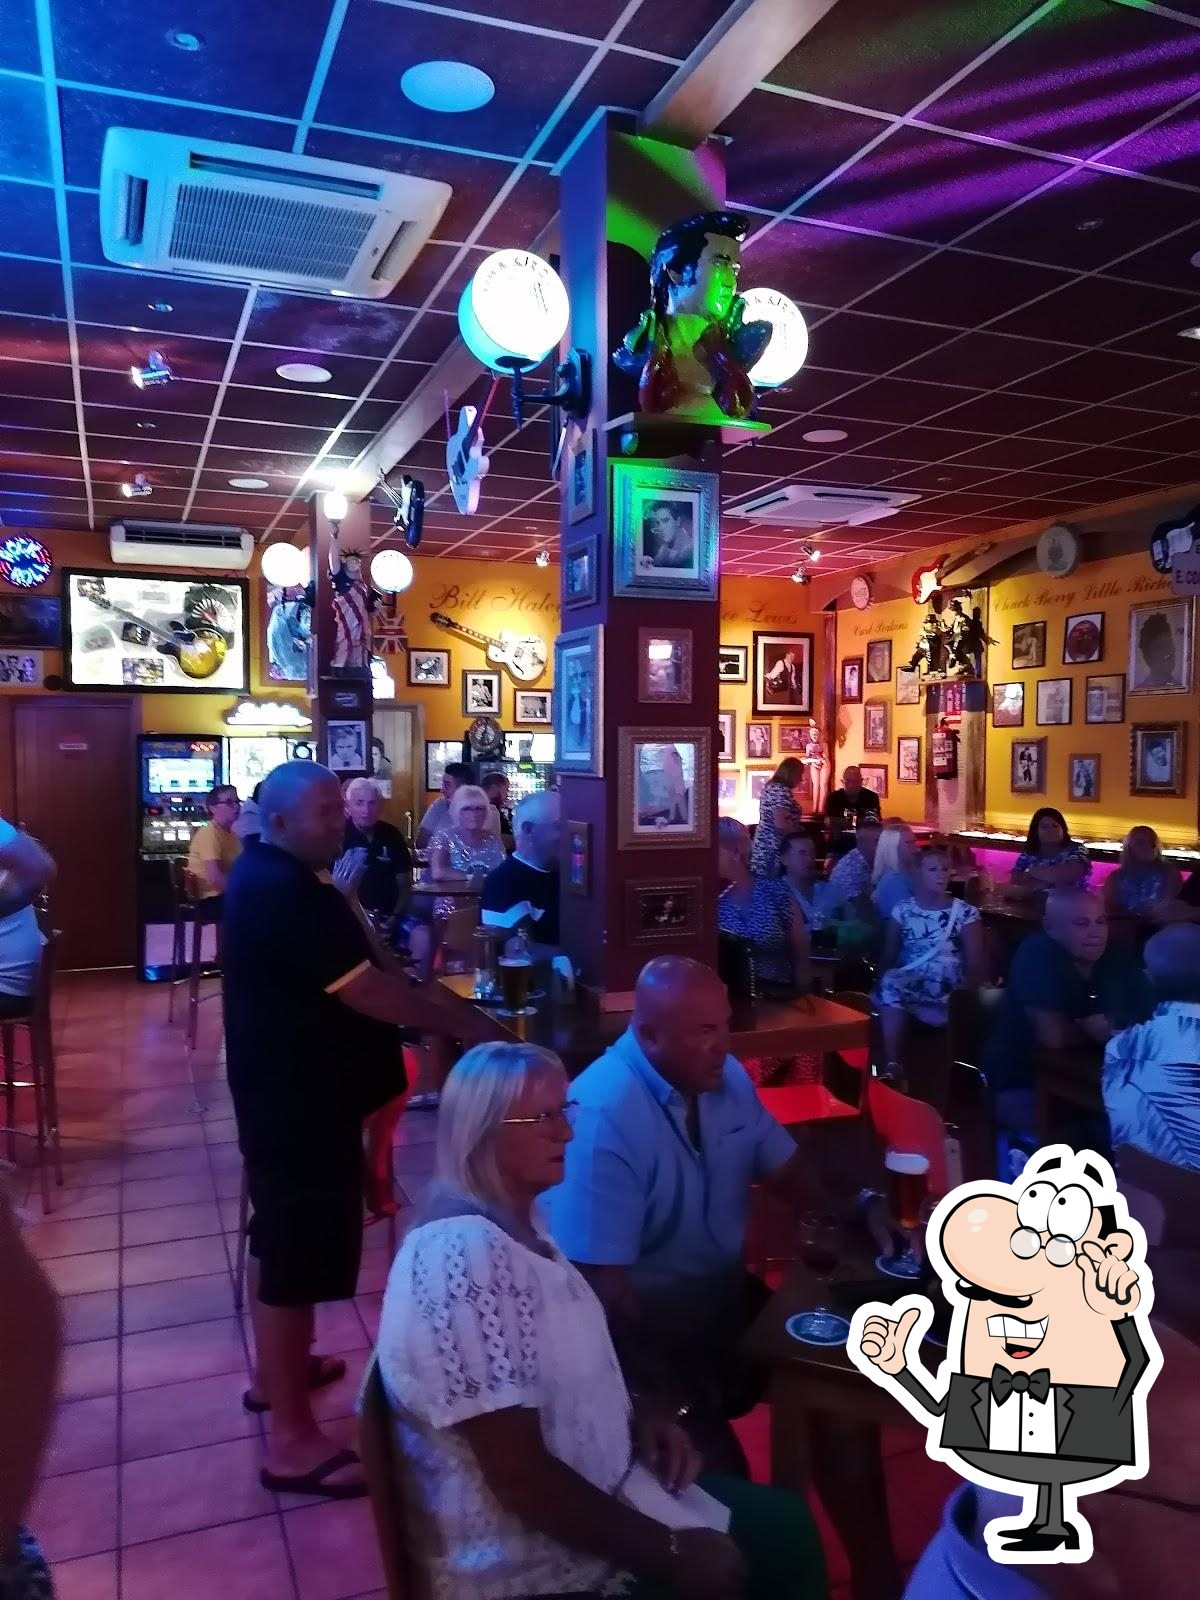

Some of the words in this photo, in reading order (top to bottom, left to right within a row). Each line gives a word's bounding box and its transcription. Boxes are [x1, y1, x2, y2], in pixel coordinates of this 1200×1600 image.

[428, 582, 487, 611] Bill
[993, 592, 1031, 612] Chuck
[1033, 588, 1076, 608] Berry
[1083, 579, 1122, 600] Little
[745, 600, 798, 625] Lewis
